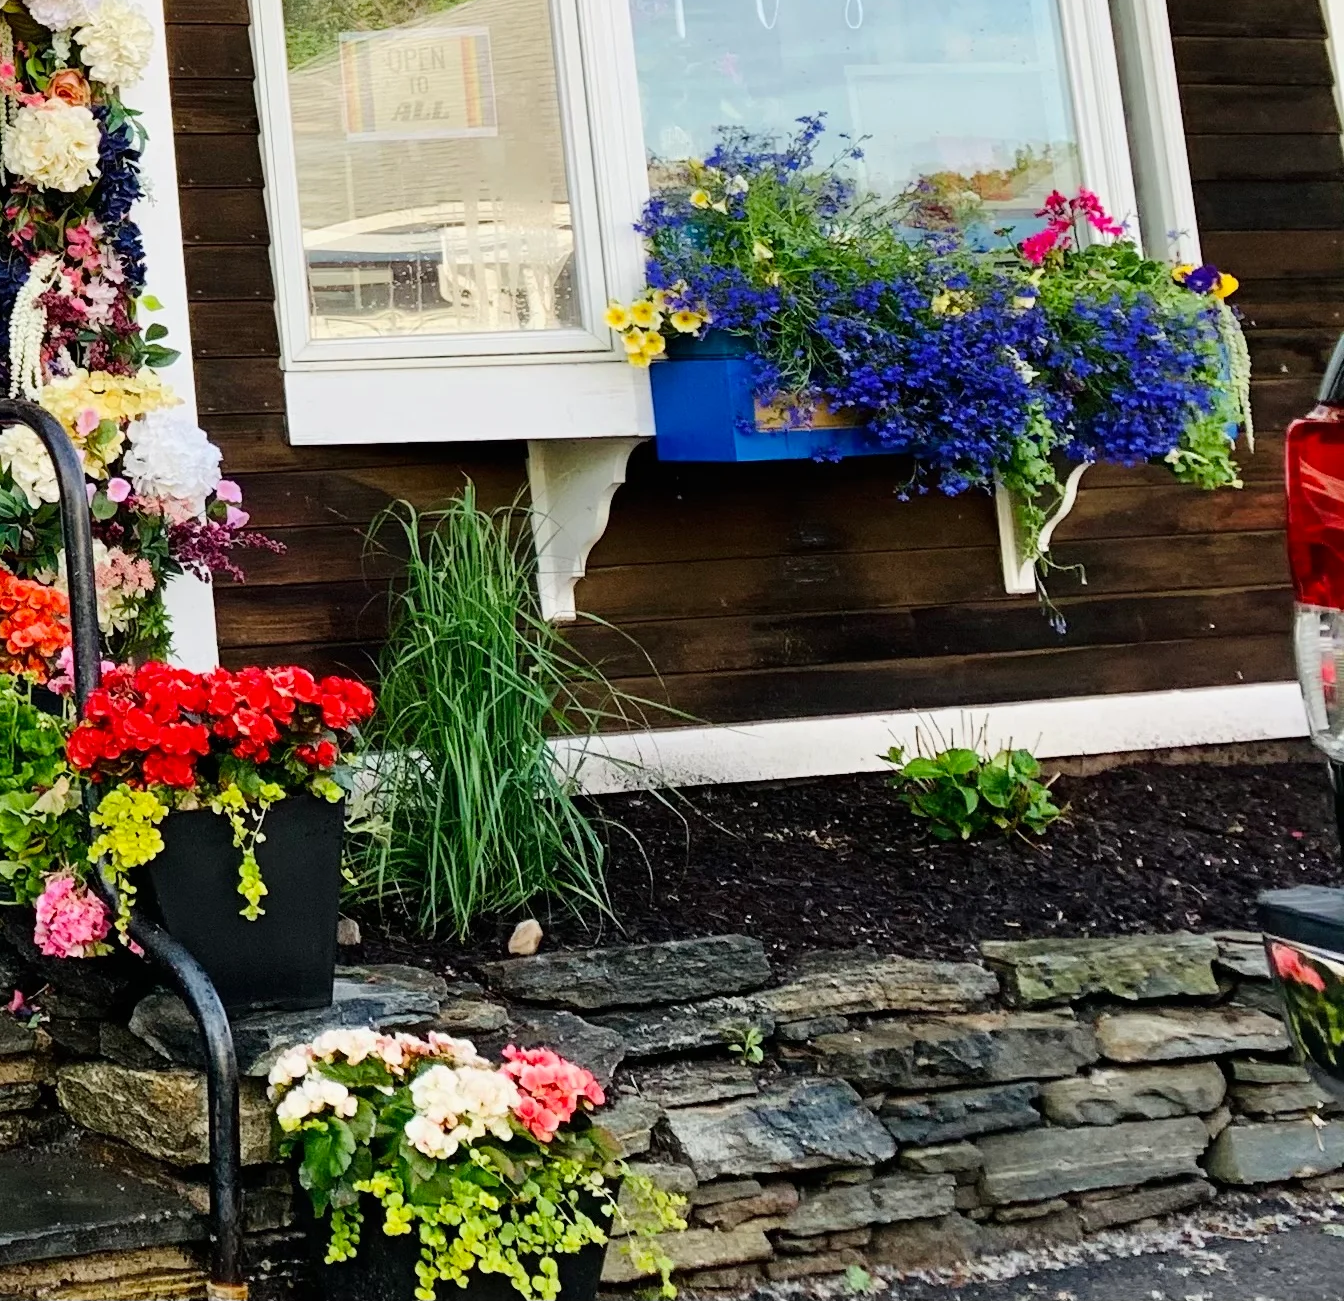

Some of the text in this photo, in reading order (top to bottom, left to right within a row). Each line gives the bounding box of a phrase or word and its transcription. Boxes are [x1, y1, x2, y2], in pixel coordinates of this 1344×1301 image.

[387, 45, 447, 73] OPEN
[407, 75, 430, 95] TO
[391, 100, 451, 122] ALL
